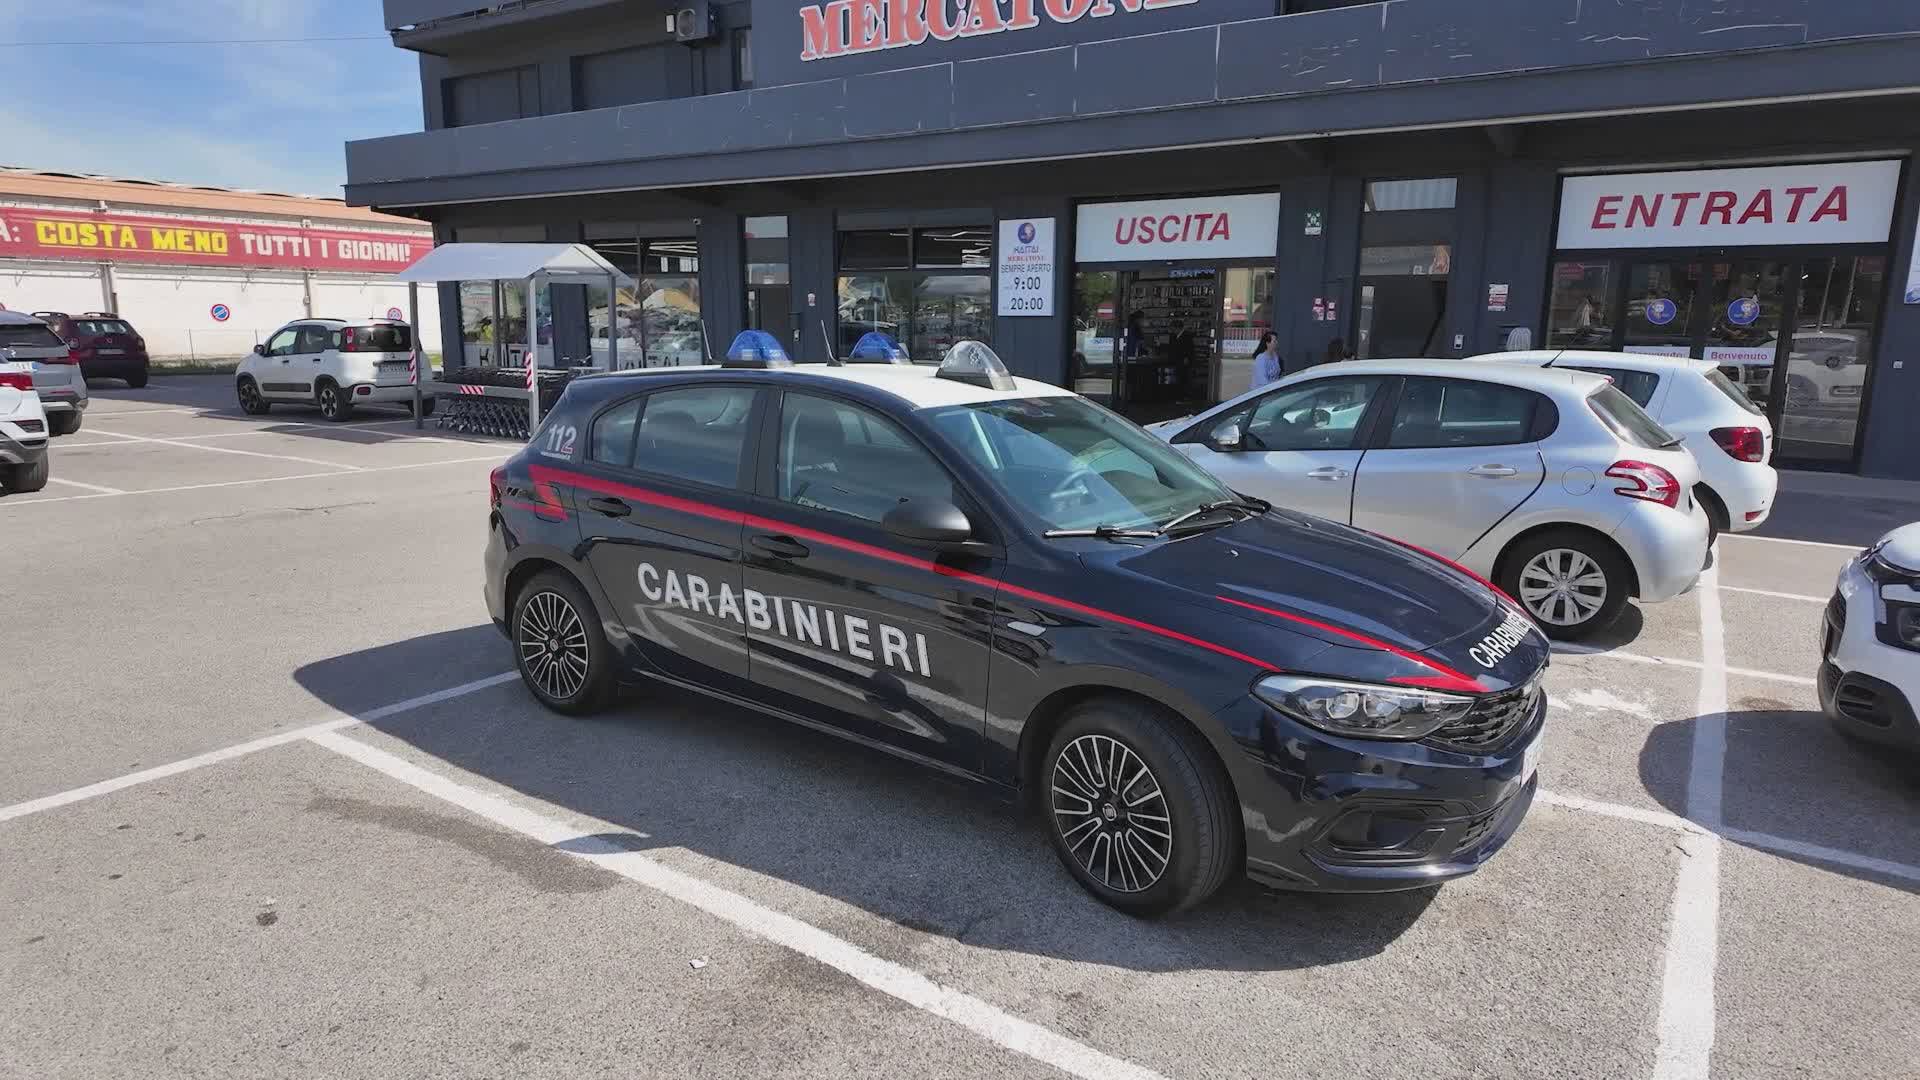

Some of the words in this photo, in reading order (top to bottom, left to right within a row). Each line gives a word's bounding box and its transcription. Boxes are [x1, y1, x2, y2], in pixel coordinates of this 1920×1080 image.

[800, 0, 1198, 61] MERCAT
[1591, 186, 1848, 229] ENTRATA
[35, 220, 138, 249] COSTA
[151, 228, 228, 254] MENO
[239, 232, 311, 258] TUTTI
[320, 238, 329, 259] I
[338, 239, 411, 263] GIORNI!
[1115, 212, 1230, 245] USCITA
[1001, 264, 1025, 273] SEMPRE
[1027, 263, 1052, 272] APERTO
[1014, 276, 1041, 290] 9:00
[1010, 297, 1044, 310] 20:00
[1710, 351, 1768, 361] Benvenuto
[546, 424, 577, 455] 112
[637, 562, 931, 677] CARABINIERI
